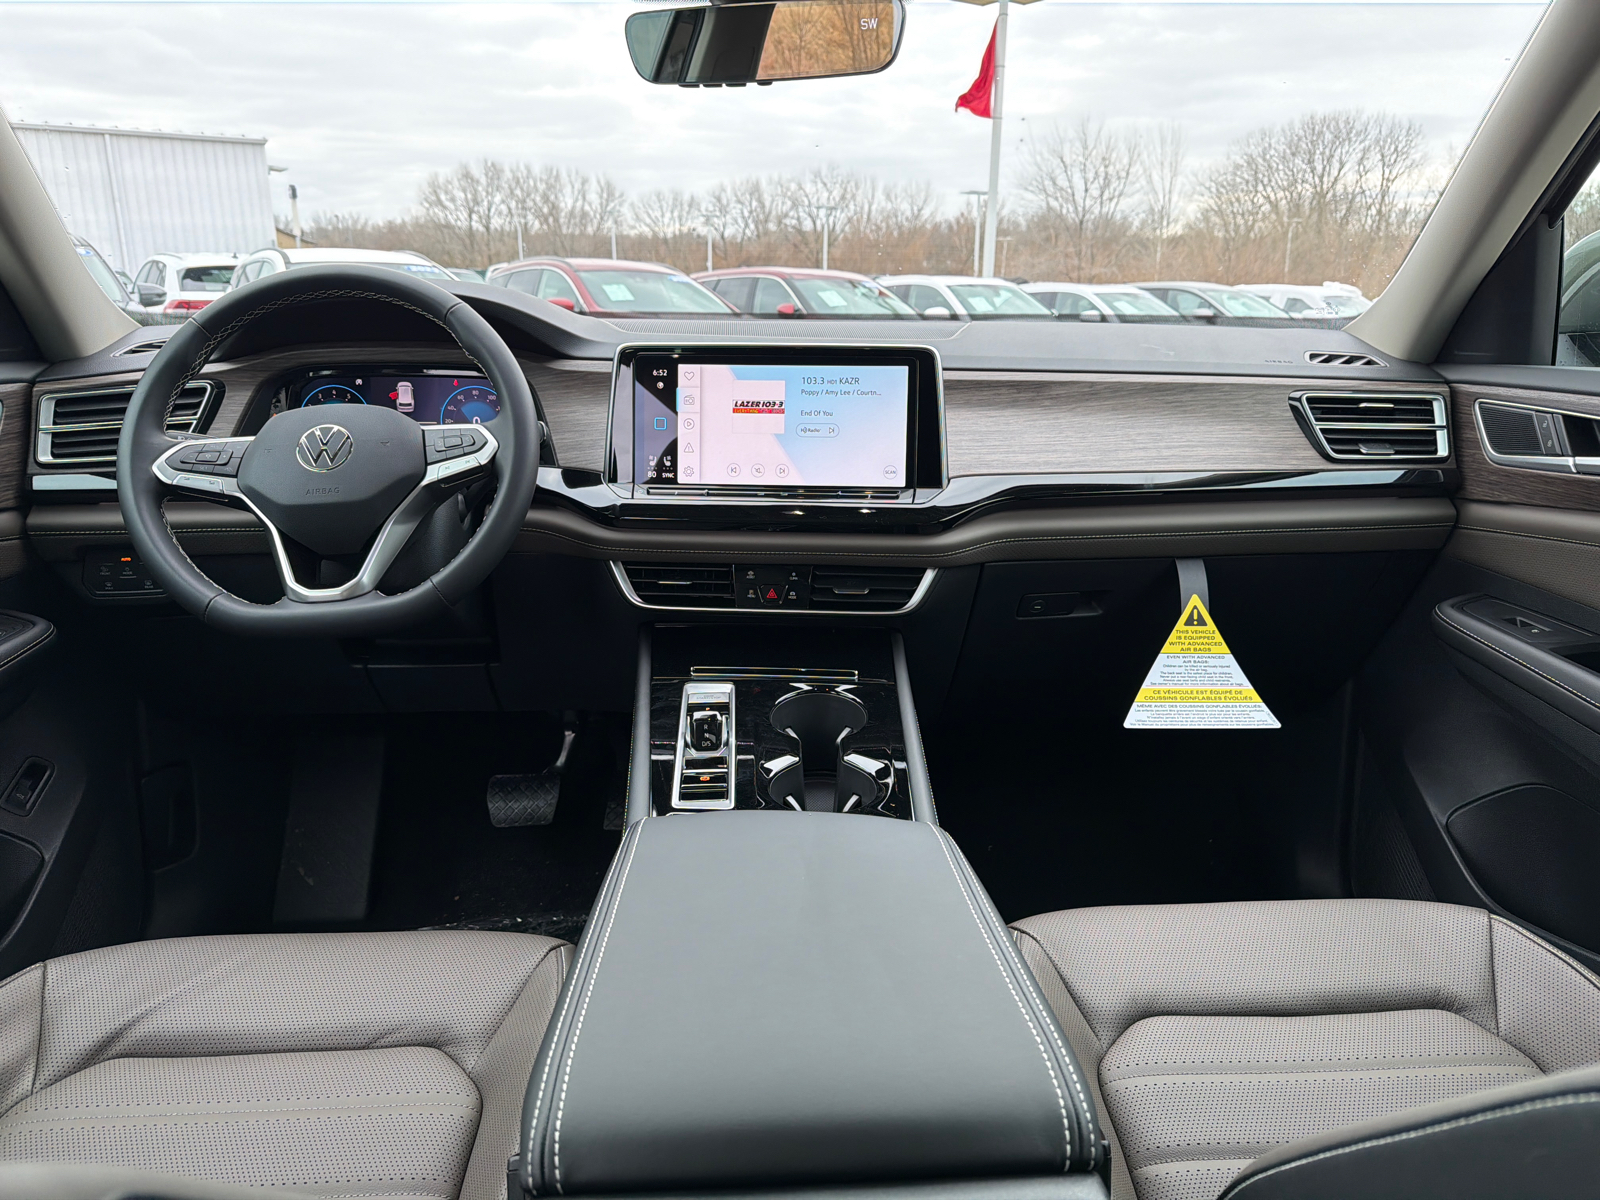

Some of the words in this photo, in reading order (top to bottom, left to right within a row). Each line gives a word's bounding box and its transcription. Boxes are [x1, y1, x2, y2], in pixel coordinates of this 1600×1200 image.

[861, 17, 878, 30] SW
[802, 377, 825, 385] 103.3
[839, 377, 860, 385] KAZR
[801, 389, 819, 397] Poppy
[825, 389, 838, 397] Amy
[735, 400, 761, 408] LAZER
[297, 425, 353, 471] VW
[305, 487, 340, 496] AIRBAG
